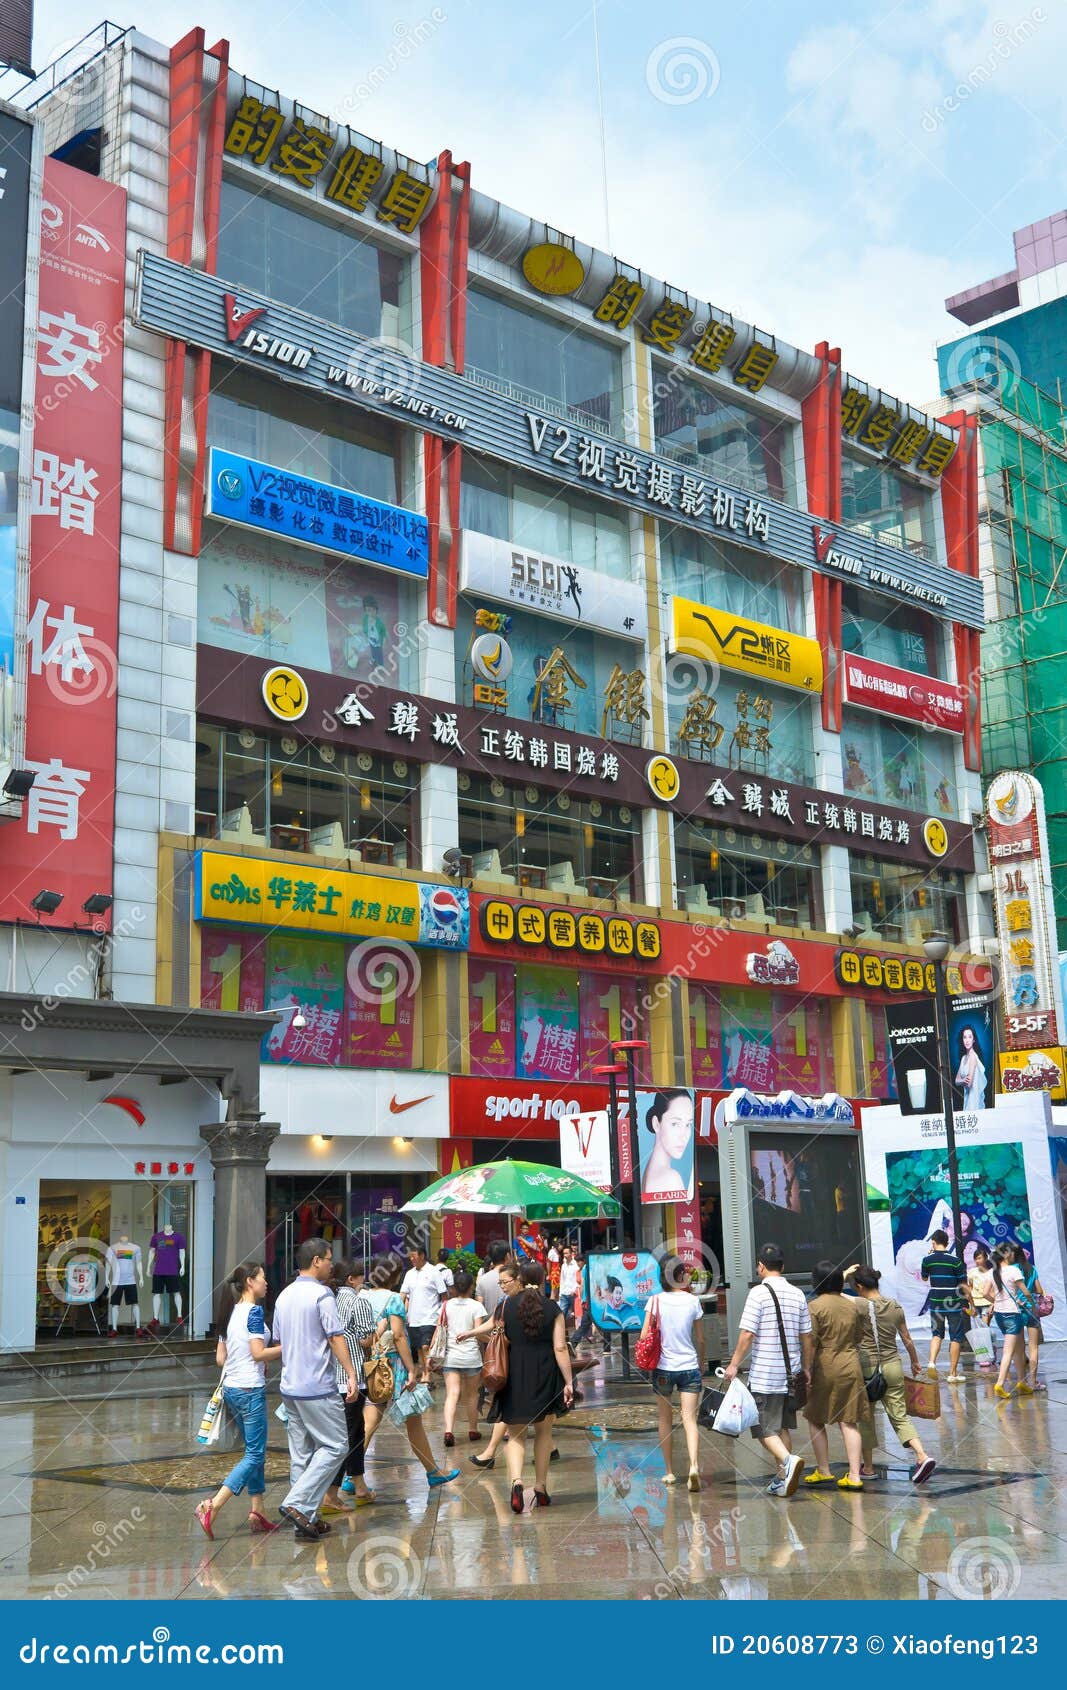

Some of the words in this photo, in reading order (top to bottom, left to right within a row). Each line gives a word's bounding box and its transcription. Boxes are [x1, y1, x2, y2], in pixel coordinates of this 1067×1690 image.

[225, 95, 434, 234] 韵姿健身
[74, 233, 97, 248] ANTA
[594, 273, 779, 393] 韵姿健身
[841, 387, 958, 476] 韵姿健身
[526, 412, 771, 542] V2视觉摄影机构
[26, 311, 101, 840] 安踏体育
[622, 616, 635, 630] 4F
[480, 727, 620, 783] 正统韩国烧烤
[805, 801, 910, 845] 正统韩国烧烤
[267, 876, 342, 916] 华莱士
[350, 899, 380, 922] 炸鸡
[386, 904, 416, 926] 汉堡
[492, 909, 656, 953] 中式营养快餐
[543, 1023, 578, 1053] 特卖
[1008, 1015, 1048, 1034] 3-5F
[539, 1049, 573, 1075] 折起
[743, 1039, 772, 1067] 特卖
[740, 1061, 768, 1088] 折起
[485, 1093, 542, 1121] sport
[653, 1191, 689, 1200] CLARIN
